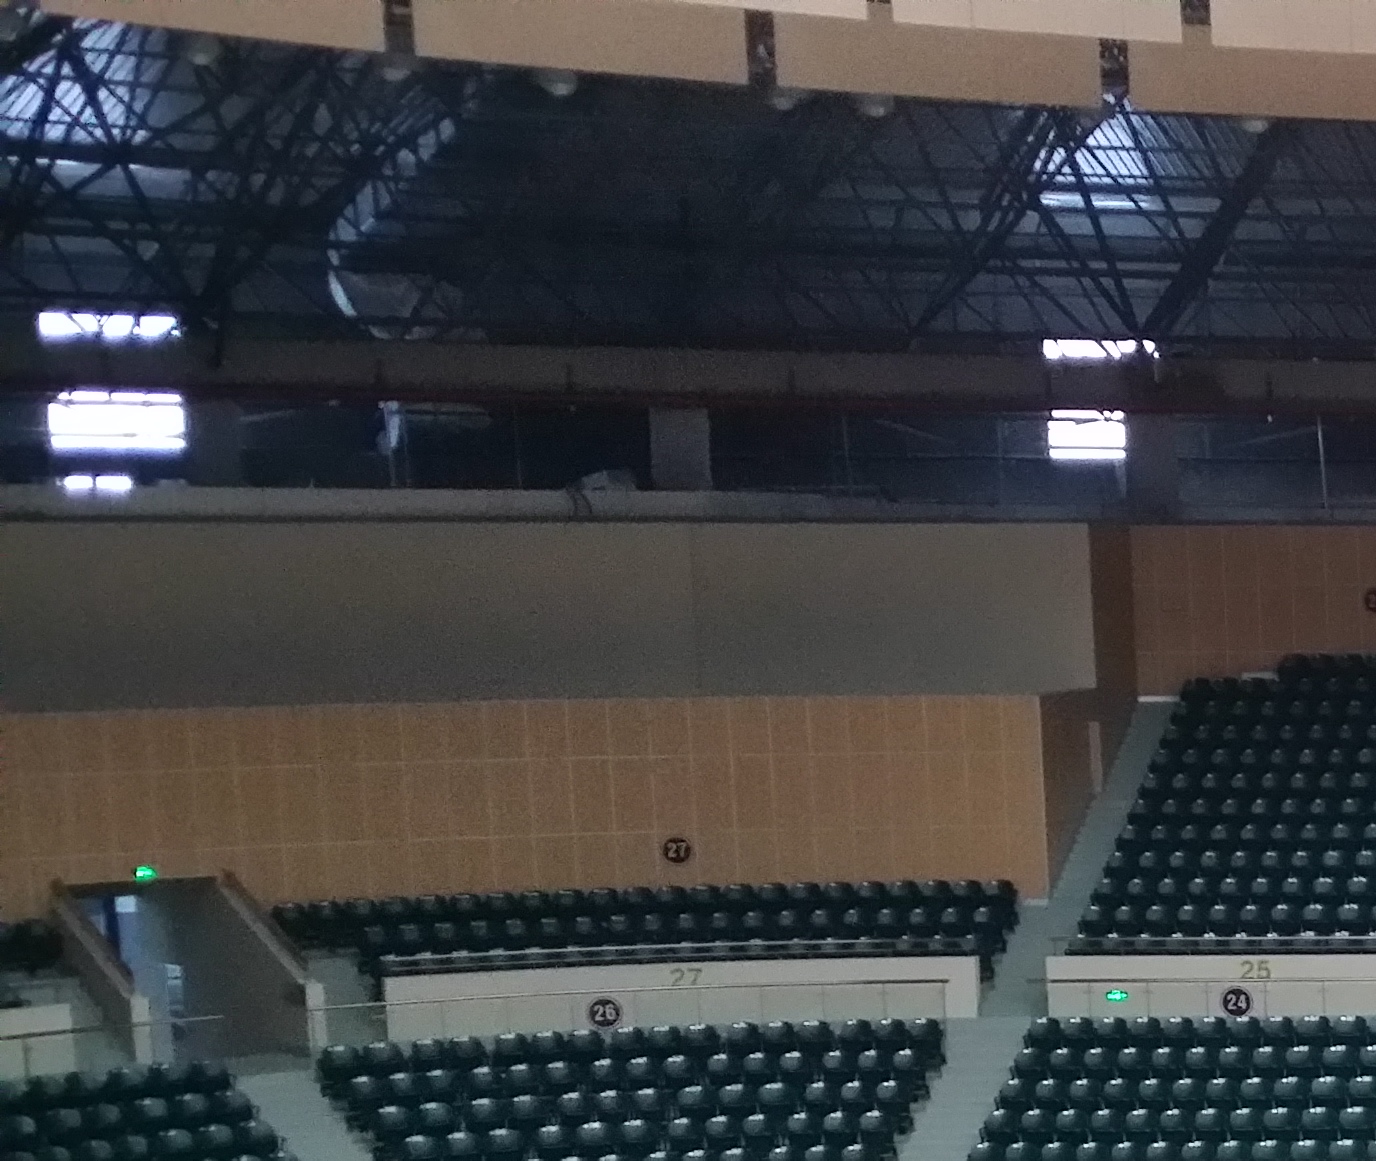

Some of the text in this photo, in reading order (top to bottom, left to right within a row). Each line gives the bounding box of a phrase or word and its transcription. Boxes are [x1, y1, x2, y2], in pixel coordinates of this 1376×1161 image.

[667, 841, 687, 859] 27
[669, 967, 704, 987] 27
[1240, 960, 1272, 980] 25
[1226, 993, 1247, 1010] 24
[593, 1004, 616, 1022] 26
